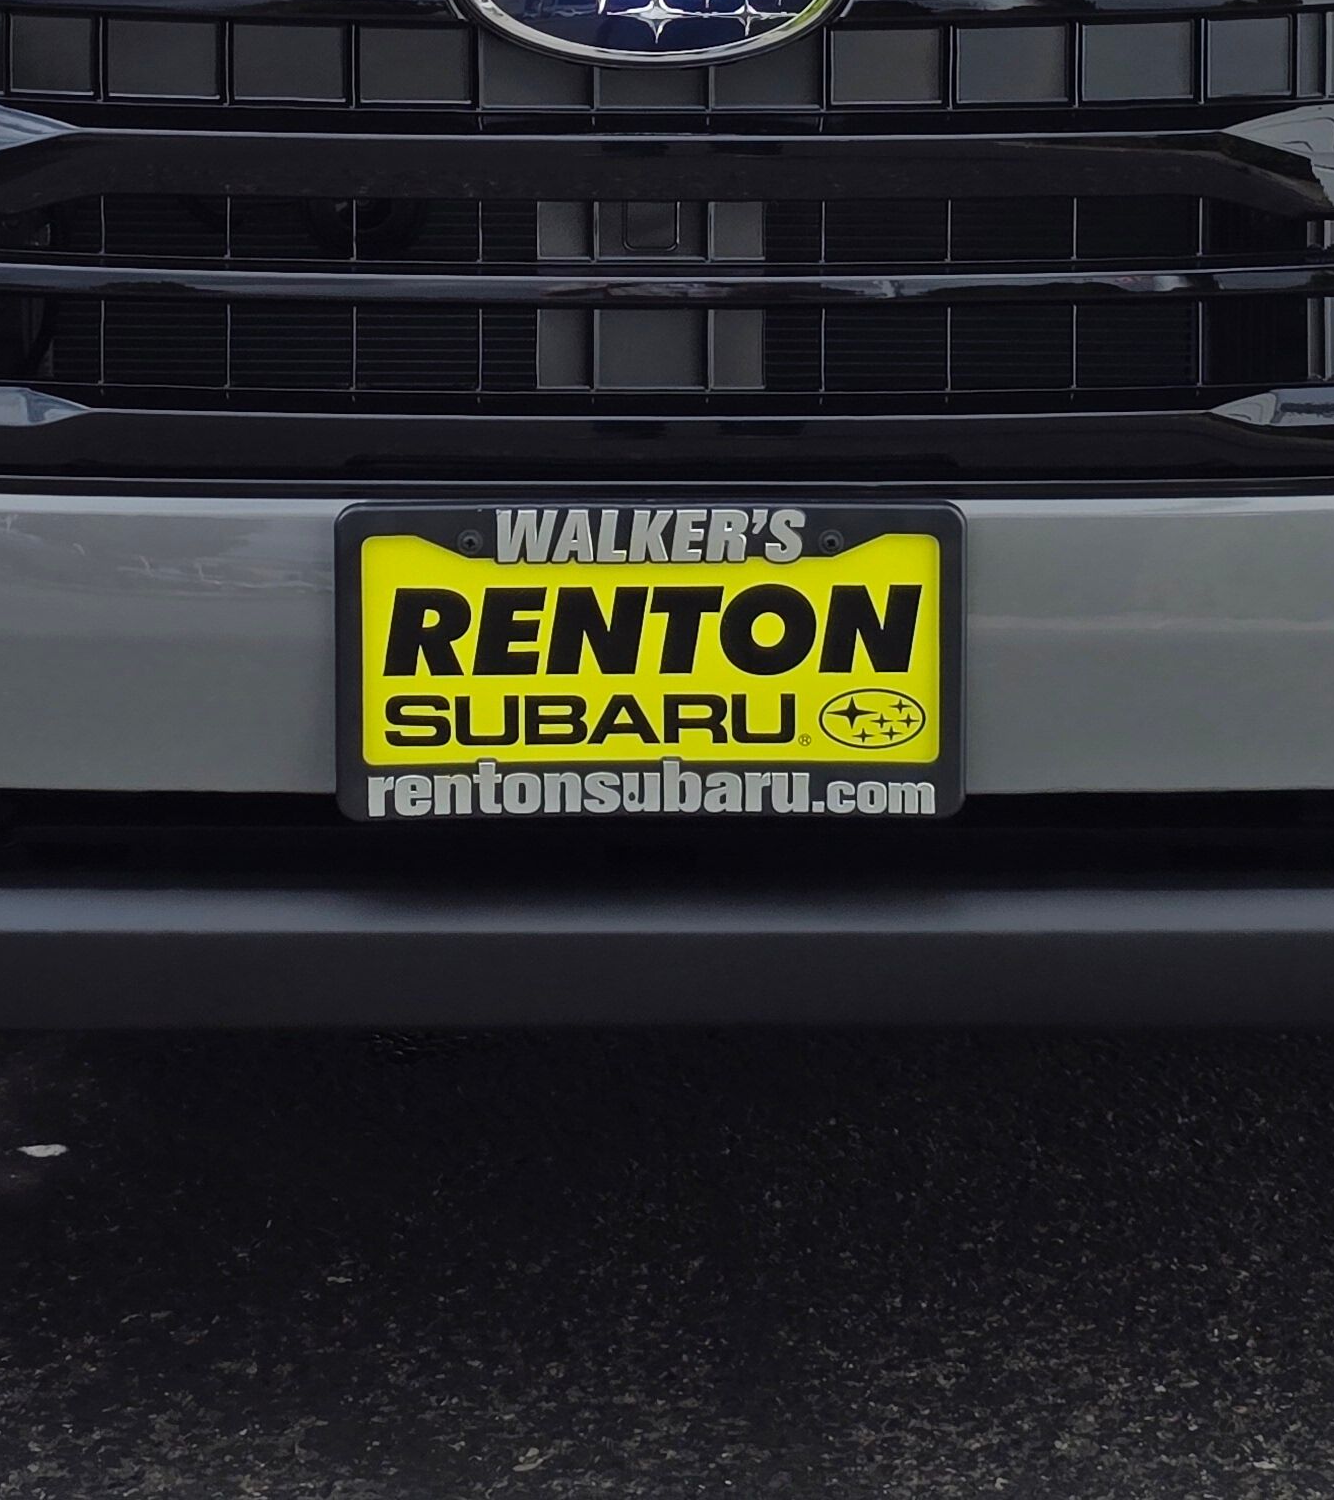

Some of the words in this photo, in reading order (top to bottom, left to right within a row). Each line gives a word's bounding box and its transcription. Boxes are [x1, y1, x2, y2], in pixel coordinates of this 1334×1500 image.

[496, 509, 807, 564] WALKER'S
[383, 583, 923, 676] RENTON
[385, 693, 796, 747] SUBARU
[368, 760, 936, 818] rentonsubaru.com
